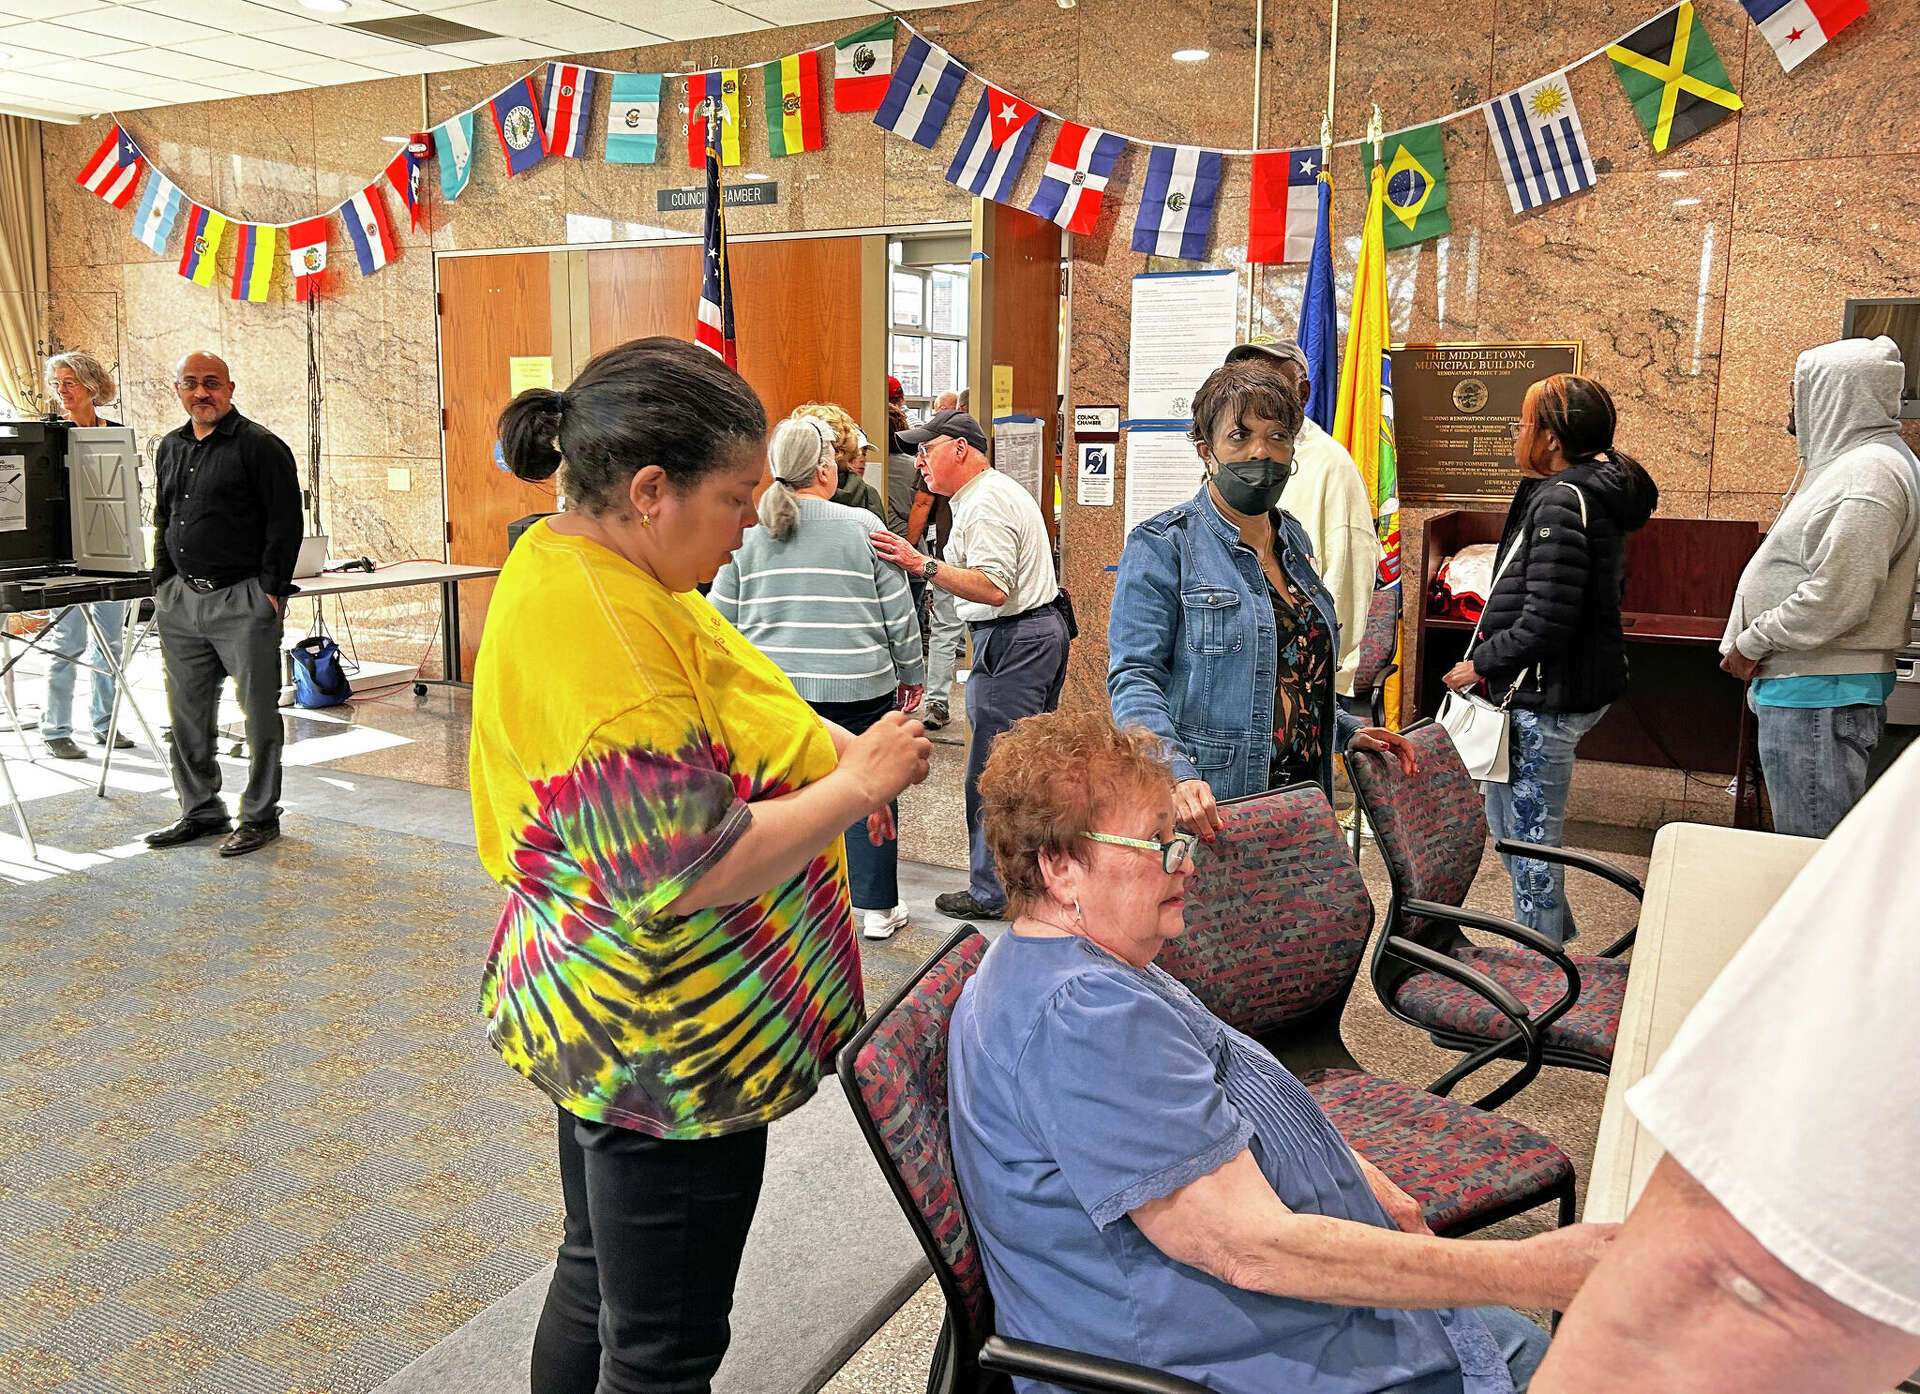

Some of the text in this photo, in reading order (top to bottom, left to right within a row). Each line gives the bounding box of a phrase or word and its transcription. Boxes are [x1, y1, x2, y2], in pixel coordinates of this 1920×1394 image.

[710, 54, 719, 68] 12
[742, 73, 748, 85] 2
[746, 95, 752, 107] 3
[682, 123, 689, 136] 8
[722, 187, 761, 203] HAMBER
[1426, 350, 1527, 361] THE MIDDLETOWN
[1415, 360, 1536, 370] MUNICIPAL BUILDING
